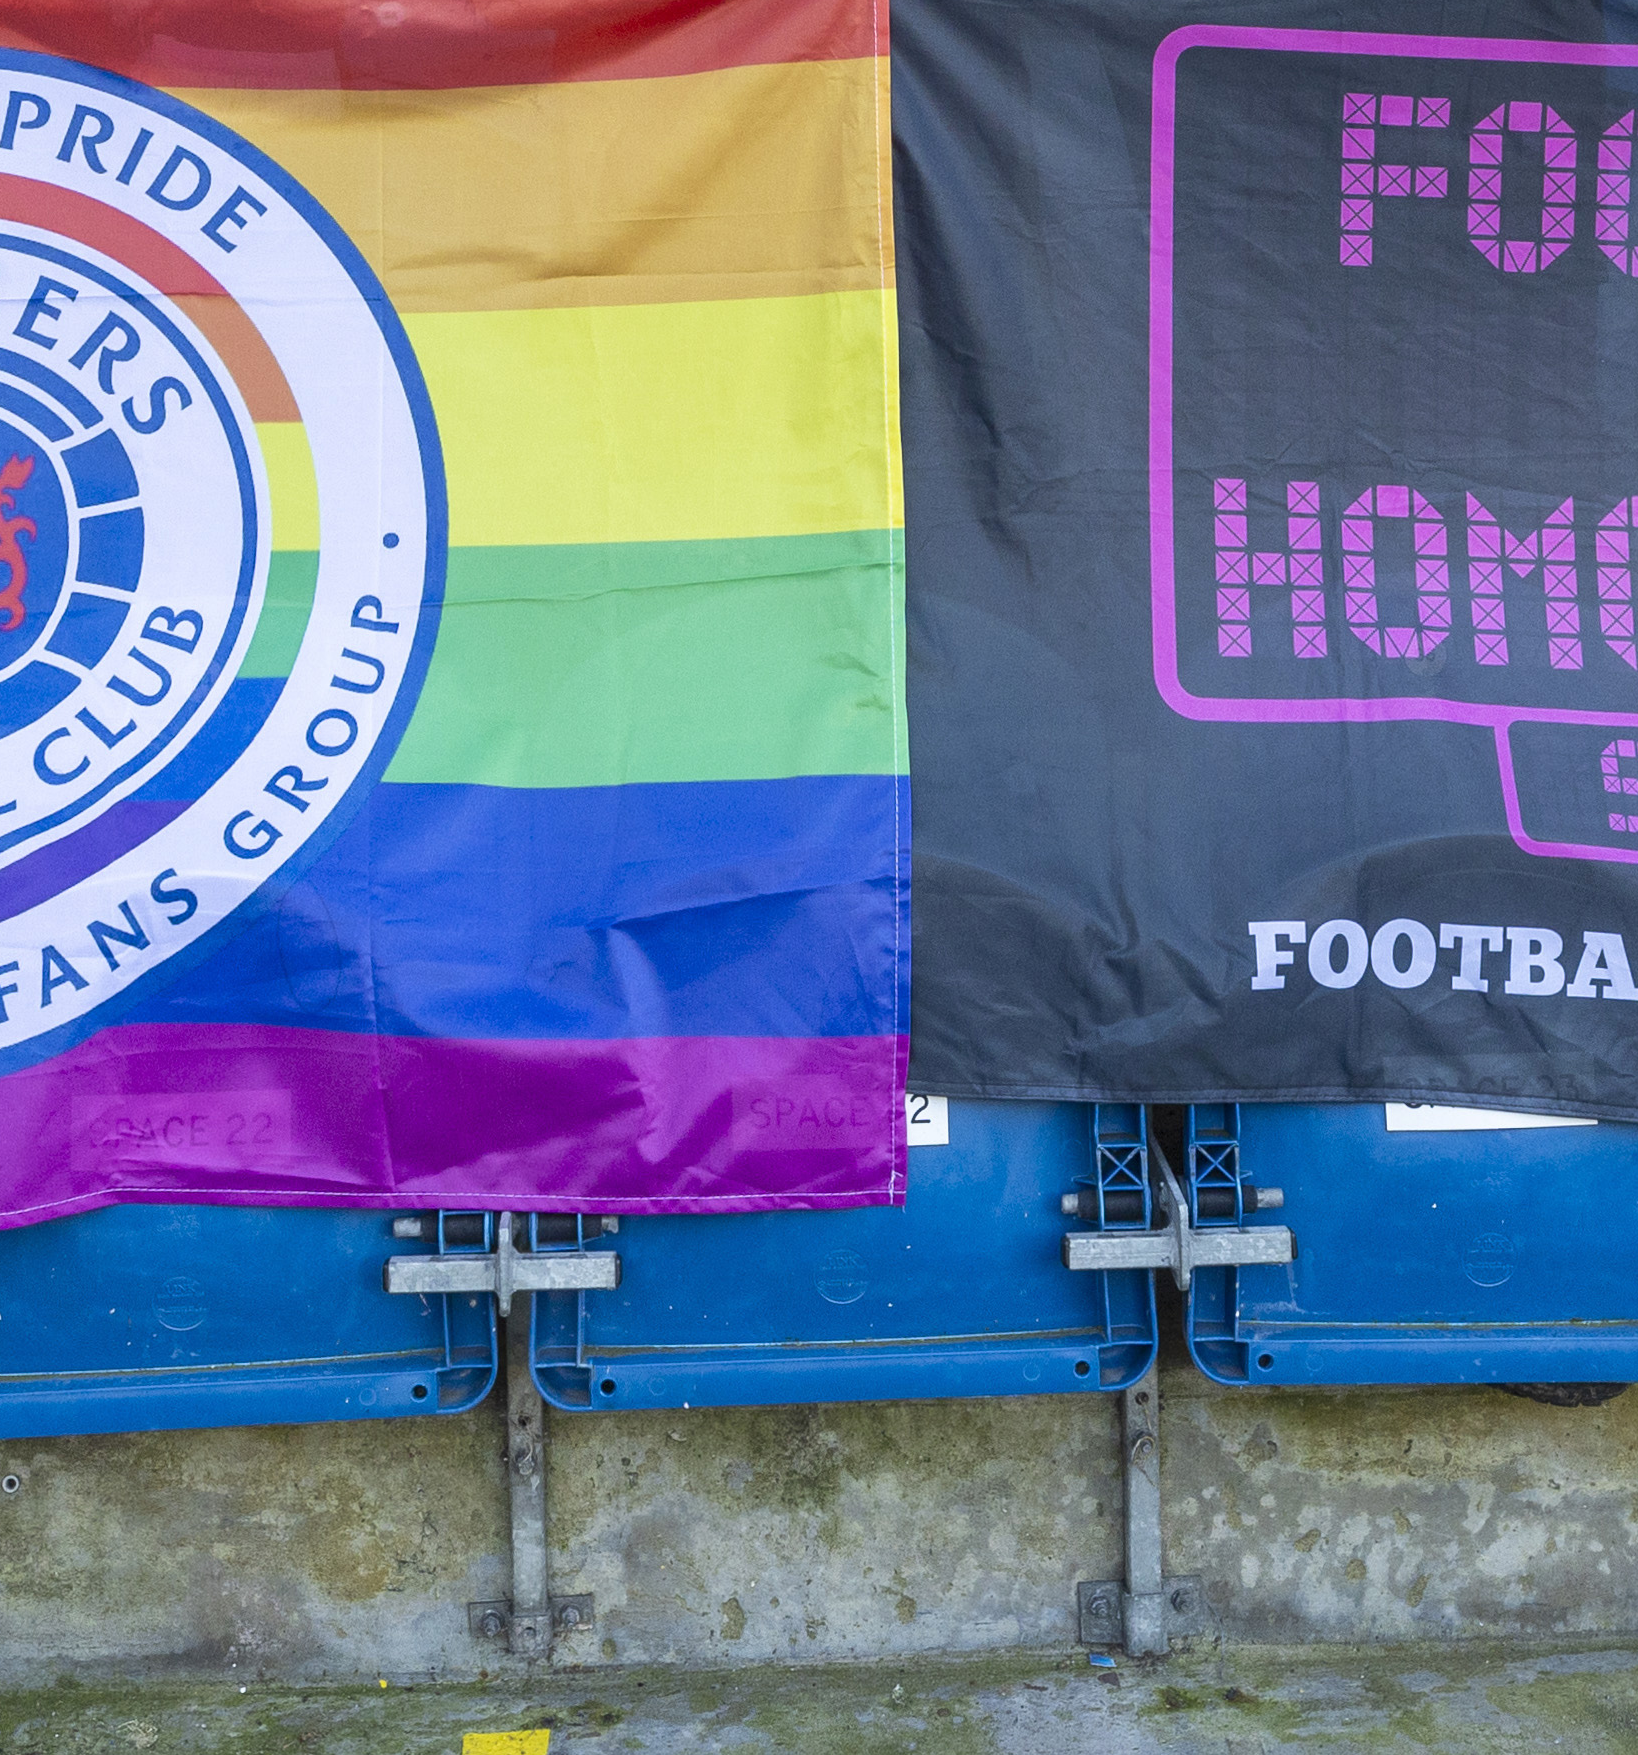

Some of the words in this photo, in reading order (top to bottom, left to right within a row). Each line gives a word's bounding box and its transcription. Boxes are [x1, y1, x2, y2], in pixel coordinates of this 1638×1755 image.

[33, 605, 204, 787] CLUB
[223, 594, 400, 861] GROUP
[751, 1097, 869, 1128] SPACE
